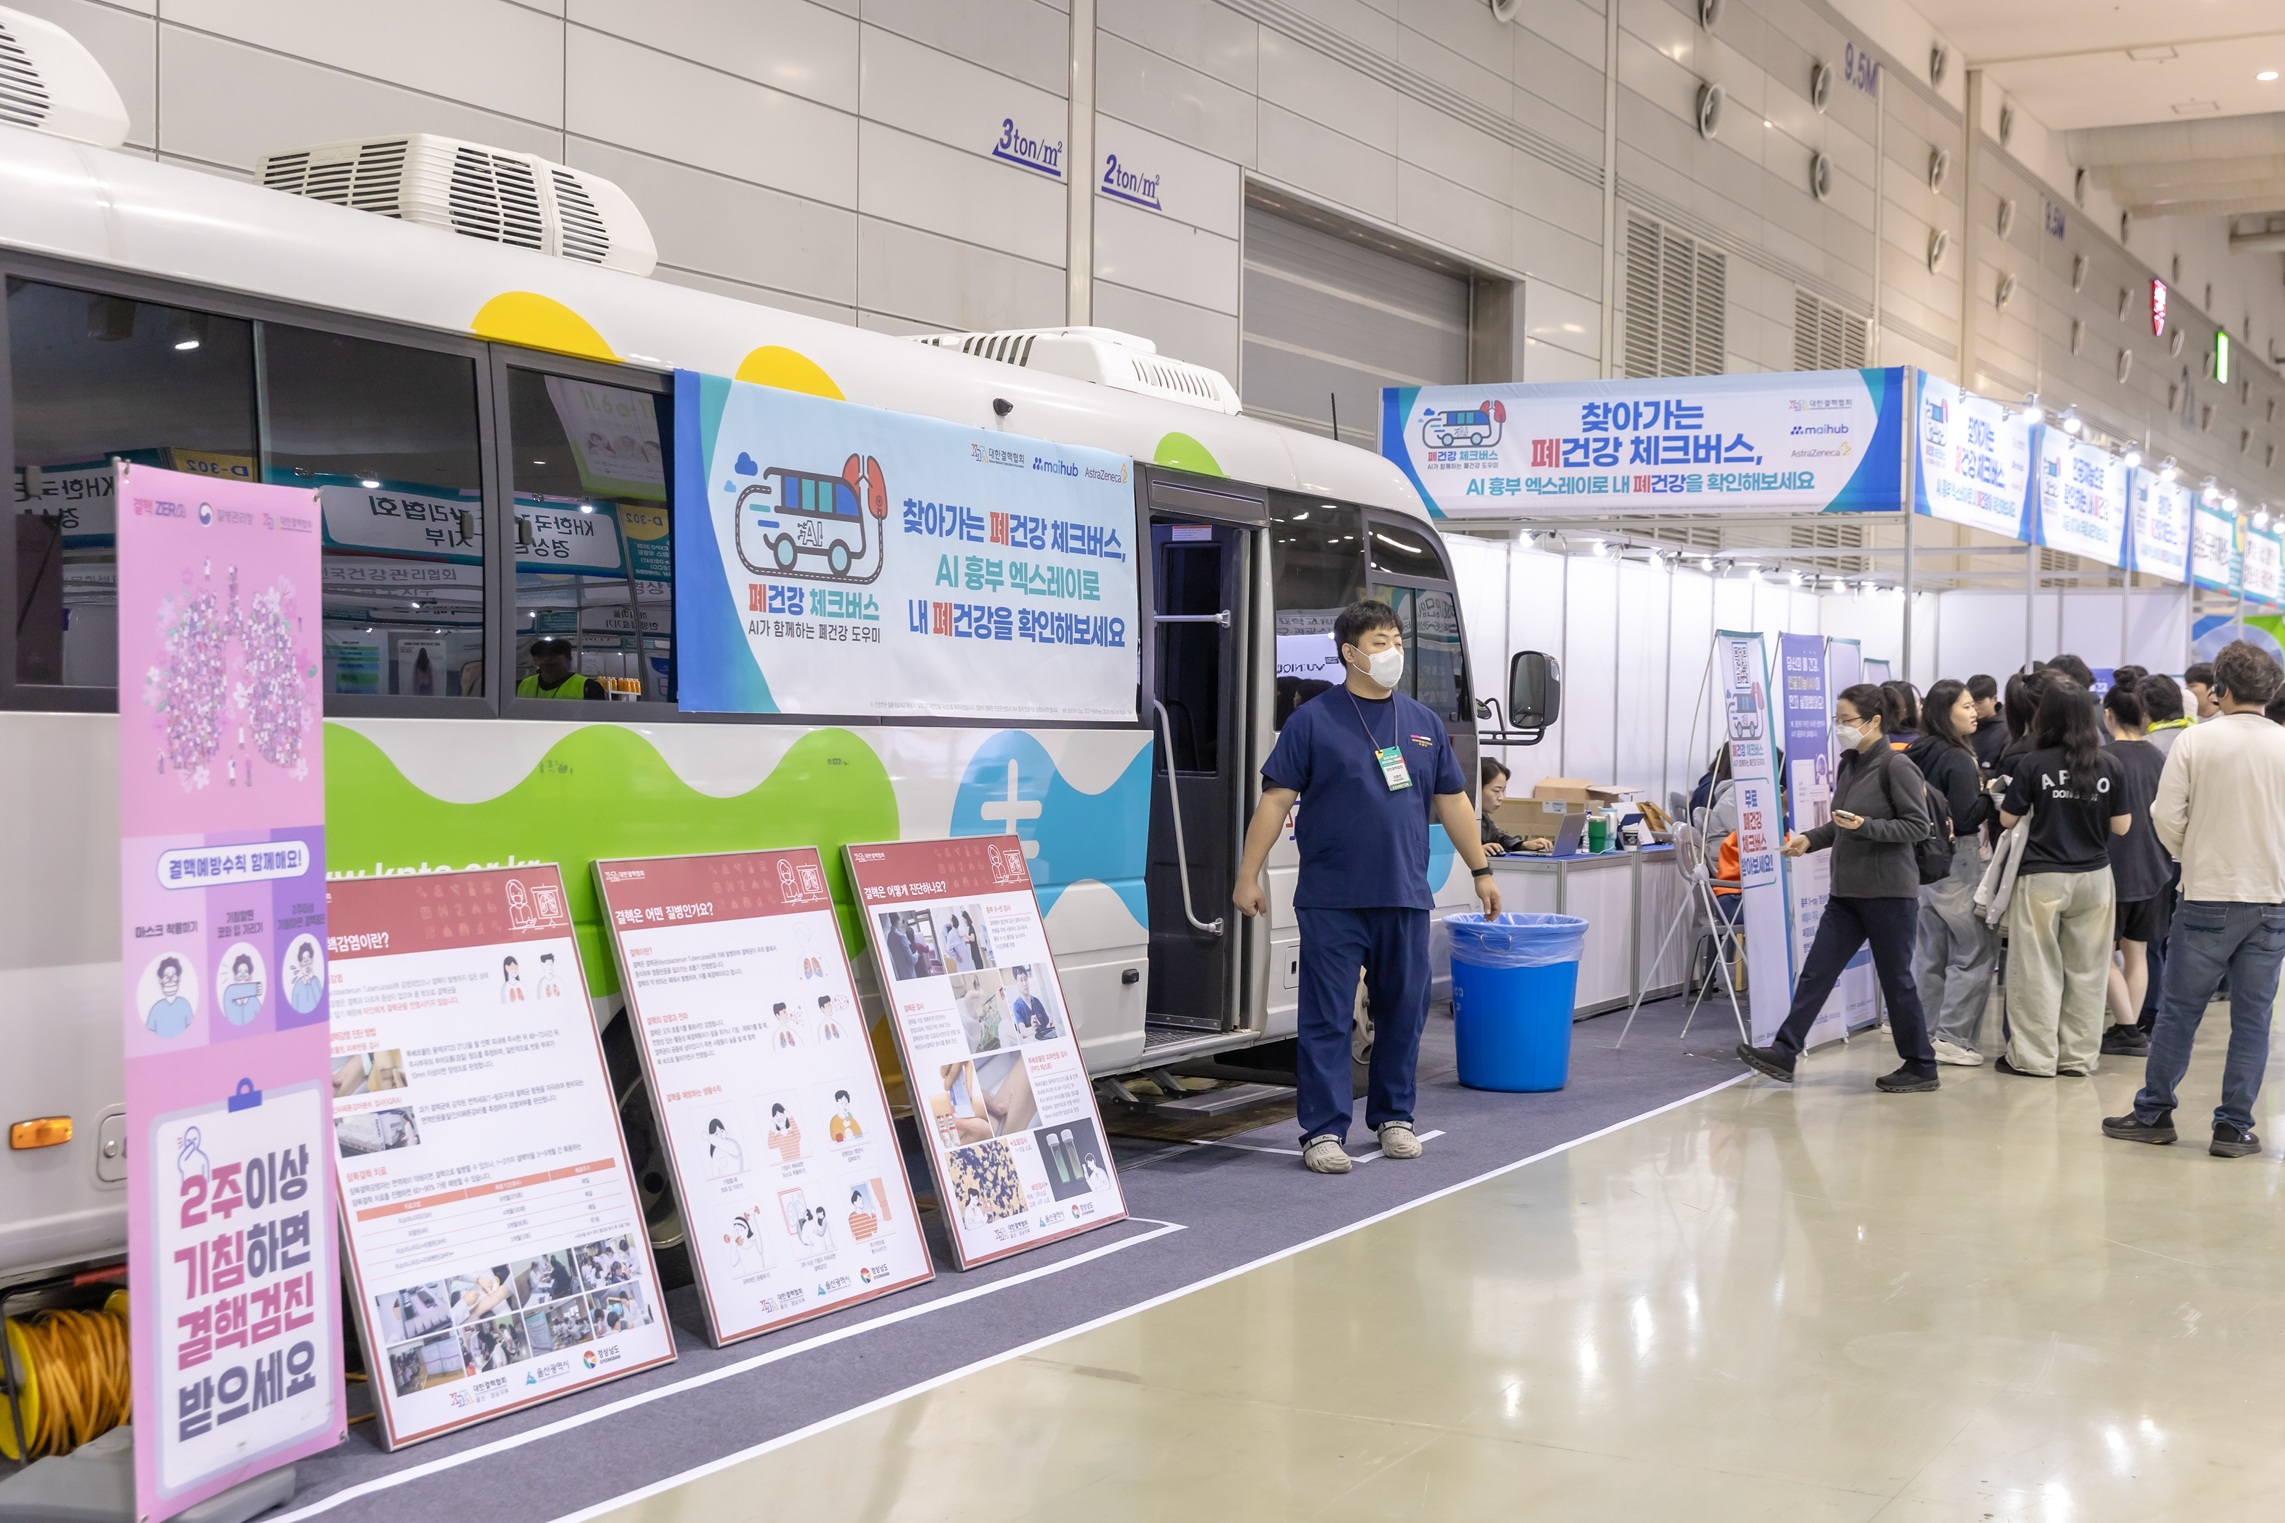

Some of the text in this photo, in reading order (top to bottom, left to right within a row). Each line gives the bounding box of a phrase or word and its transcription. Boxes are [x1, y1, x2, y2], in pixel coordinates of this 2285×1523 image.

[1844, 42, 1878, 98] 9.5M
[1582, 400, 1704, 432] 찾아가는
[1805, 424, 1848, 434] maihub
[988, 448, 1024, 464] 대한결핵협회
[1428, 450, 1498, 462] 폐건강 체크버스
[1532, 434, 1762, 468] 폐건강 체크버스,
[1791, 450, 1841, 458] AstraZeneca
[1044, 460, 1078, 477] maihub
[1084, 467, 1122, 483] AstraZeneca
[1466, 471, 1814, 496] AI 흉부 엑스레이로 내 폐건강을 확인해보세요
[904, 498, 1126, 562] 찾아가는 폐건강 체크버스,
[936, 554, 1100, 601] AI 흉부 엑스레이로
[748, 584, 880, 621] 폐건강 체크버스
[748, 622, 880, 644] AI가 함께하는 폐건강 도우미
[909, 600, 1126, 648] 내 폐건강을 확인해보세요
[1744, 790, 1758, 808] 무료
[1743, 810, 1762, 831] 폐건강
[1742, 833, 1767, 854] 체크버스
[169, 849, 302, 880] 결핵예방수칙 함께해요!
[862, 880, 948, 900] 결핵은 어떻게 진단하나요?
[614, 901, 715, 924] 결핵은 어떤 질병인가요?
[135, 921, 198, 938] 마스크 착용하기
[372, 1167, 388, 1178] 치료
[180, 1143, 310, 1230] 2주이상
[174, 1210, 312, 1300] 기침하면
[870, 1262, 888, 1275] 경상남도
[824, 1274, 851, 1291] 울산광역시
[178, 1271, 314, 1371] 결핵검진
[596, 1342, 620, 1360] 경상남도
[535, 1358, 570, 1380] 울산광역시
[178, 1340, 316, 1443] 받으세요
[472, 1375, 507, 1394] 대한결핵협회
